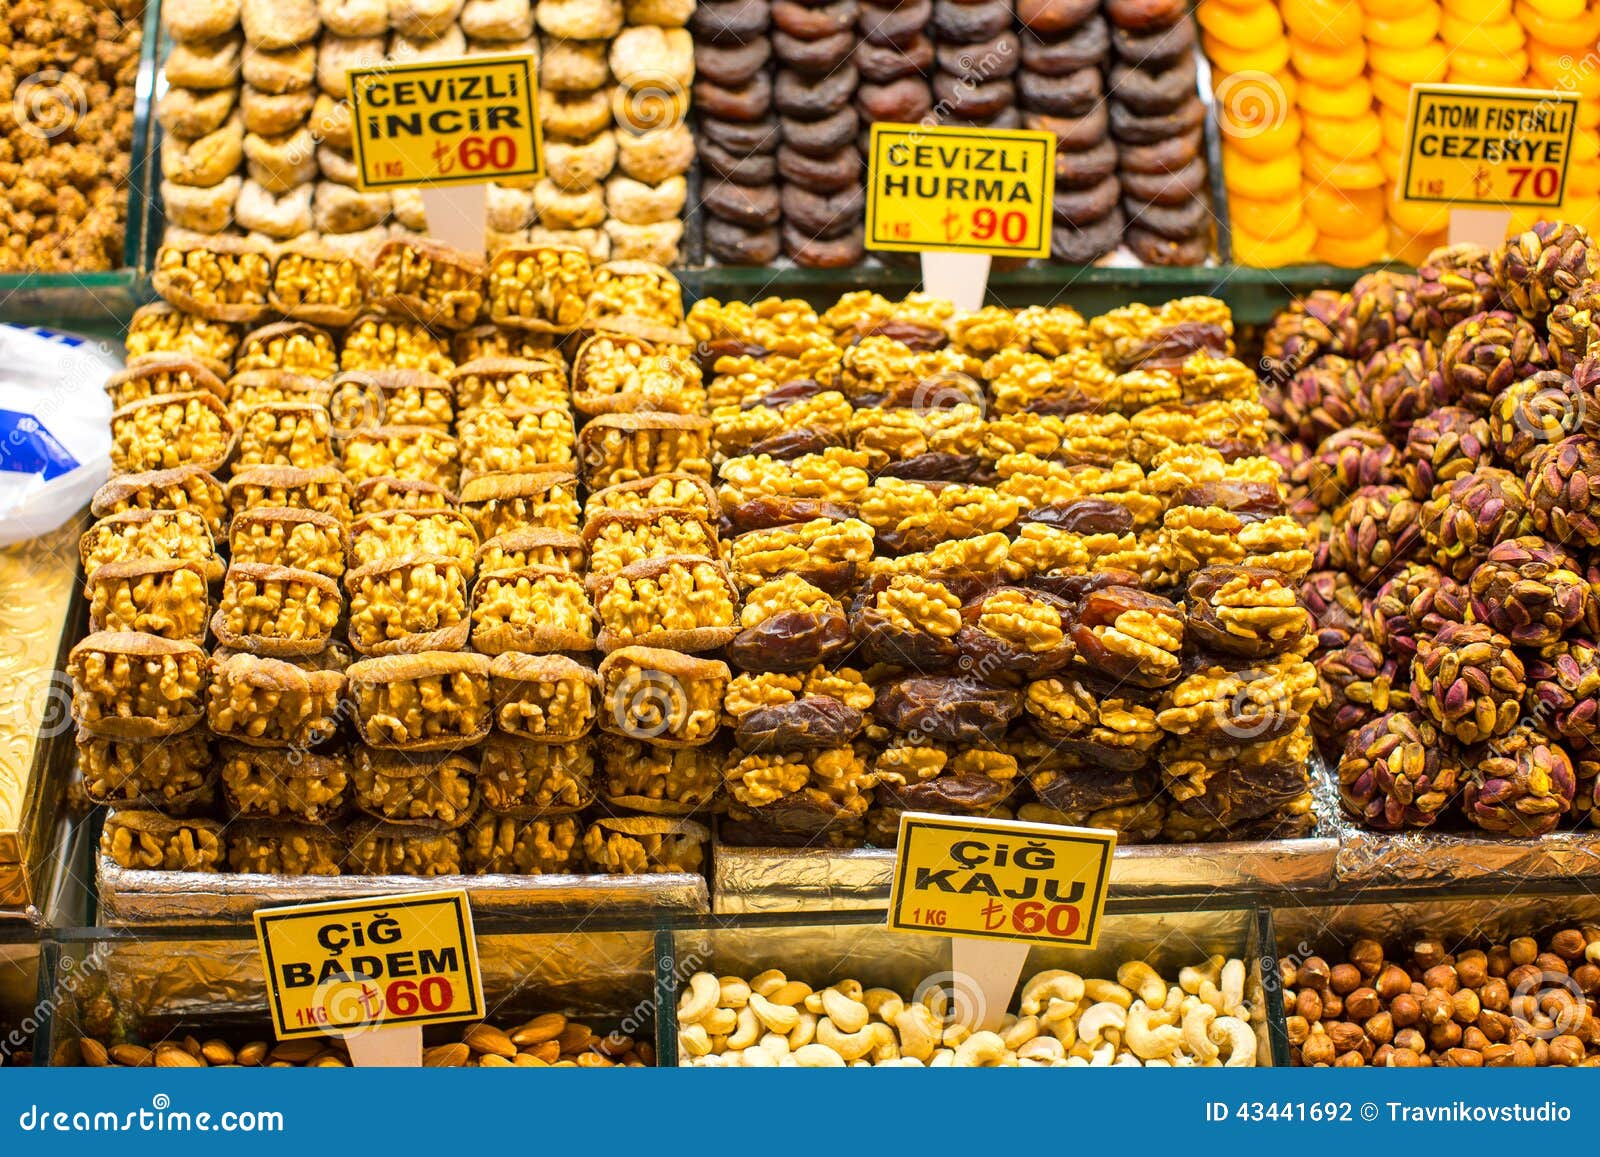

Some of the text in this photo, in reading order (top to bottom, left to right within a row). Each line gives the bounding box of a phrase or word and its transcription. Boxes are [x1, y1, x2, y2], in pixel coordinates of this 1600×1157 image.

[1423, 103, 1567, 134] ATOM FISTIKLI
[1419, 134, 1563, 164] CEZERYE
[385, 160, 404, 177] KG
[884, 174, 1033, 204] HURMA
[914, 867, 1086, 903] KAJU
[913, 908, 947, 926] 1 KG
[281, 947, 459, 989] BADEM
